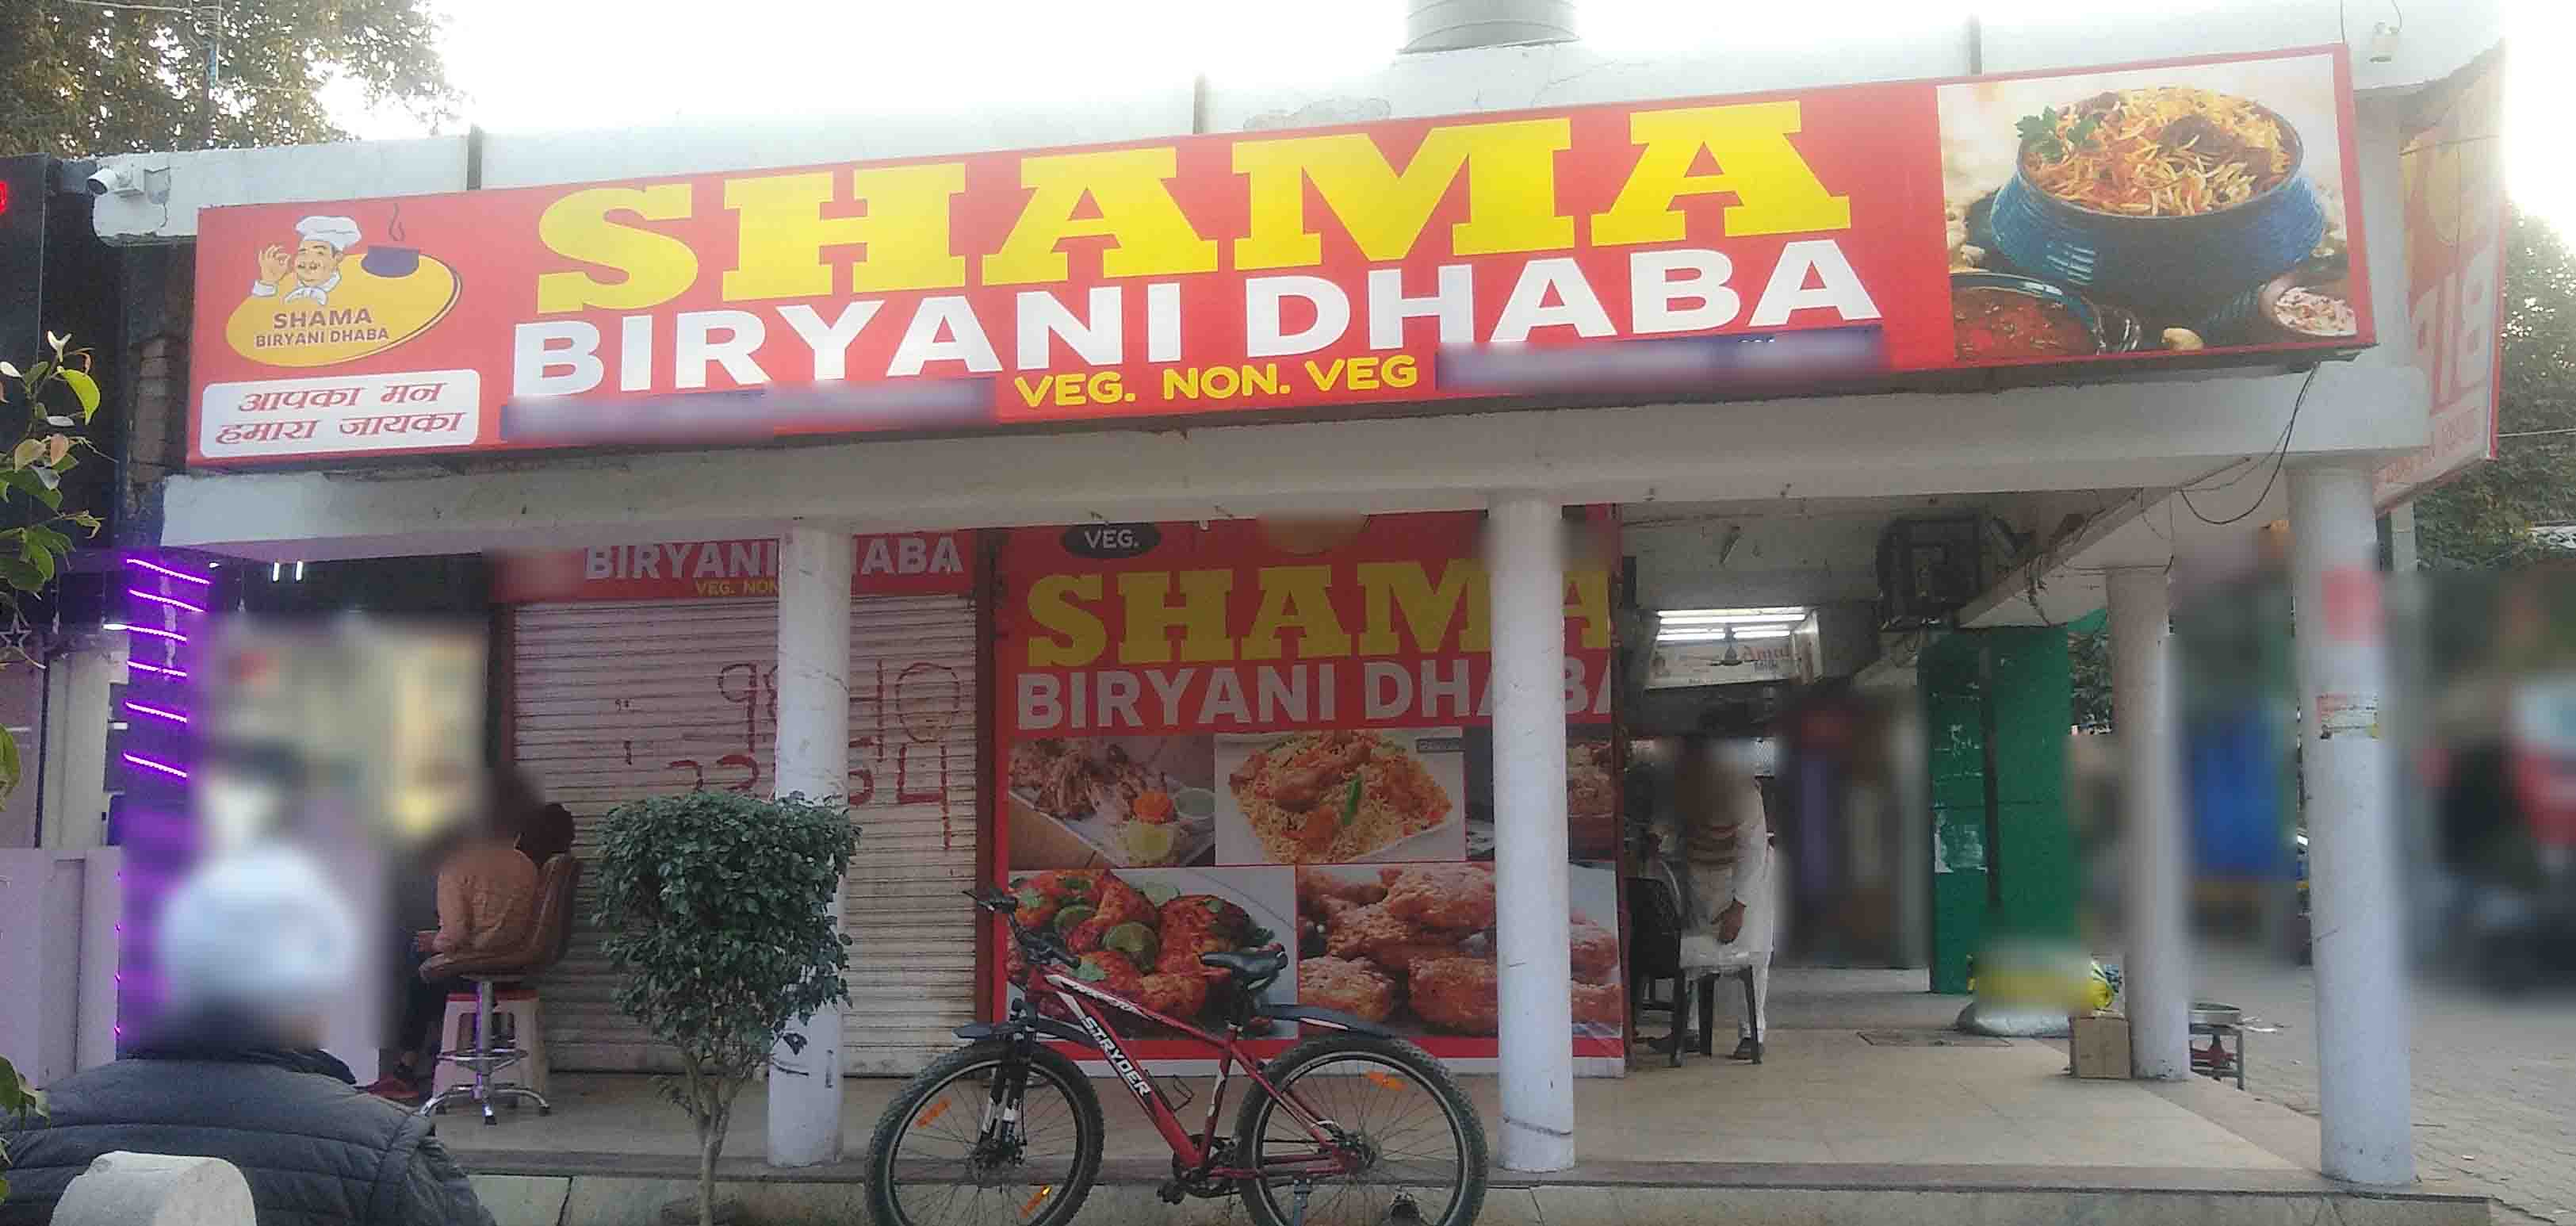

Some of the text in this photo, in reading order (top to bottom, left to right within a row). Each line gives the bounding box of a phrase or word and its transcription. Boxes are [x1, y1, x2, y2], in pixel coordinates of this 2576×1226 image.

[537, 100, 1853, 315] SHAMA
[255, 328, 389, 347] BIRYANI DHABA
[274, 308, 372, 329] SHAMA
[512, 282, 1181, 398] BIRYANI
[1245, 239, 1883, 359] DHABA
[239, 381, 449, 412] आपका मन
[1015, 371, 1136, 408] VEG.
[1162, 362, 1291, 400] NON.
[1304, 354, 1418, 392] VEG
[215, 412, 468, 445] हमारा जायका
[586, 536, 965, 580] BIRYANI ABA
[1084, 529, 1140, 549] VEG.
[1017, 664, 1337, 730] BIRYANI
[1081, 1016, 1152, 1097] STRYDER
